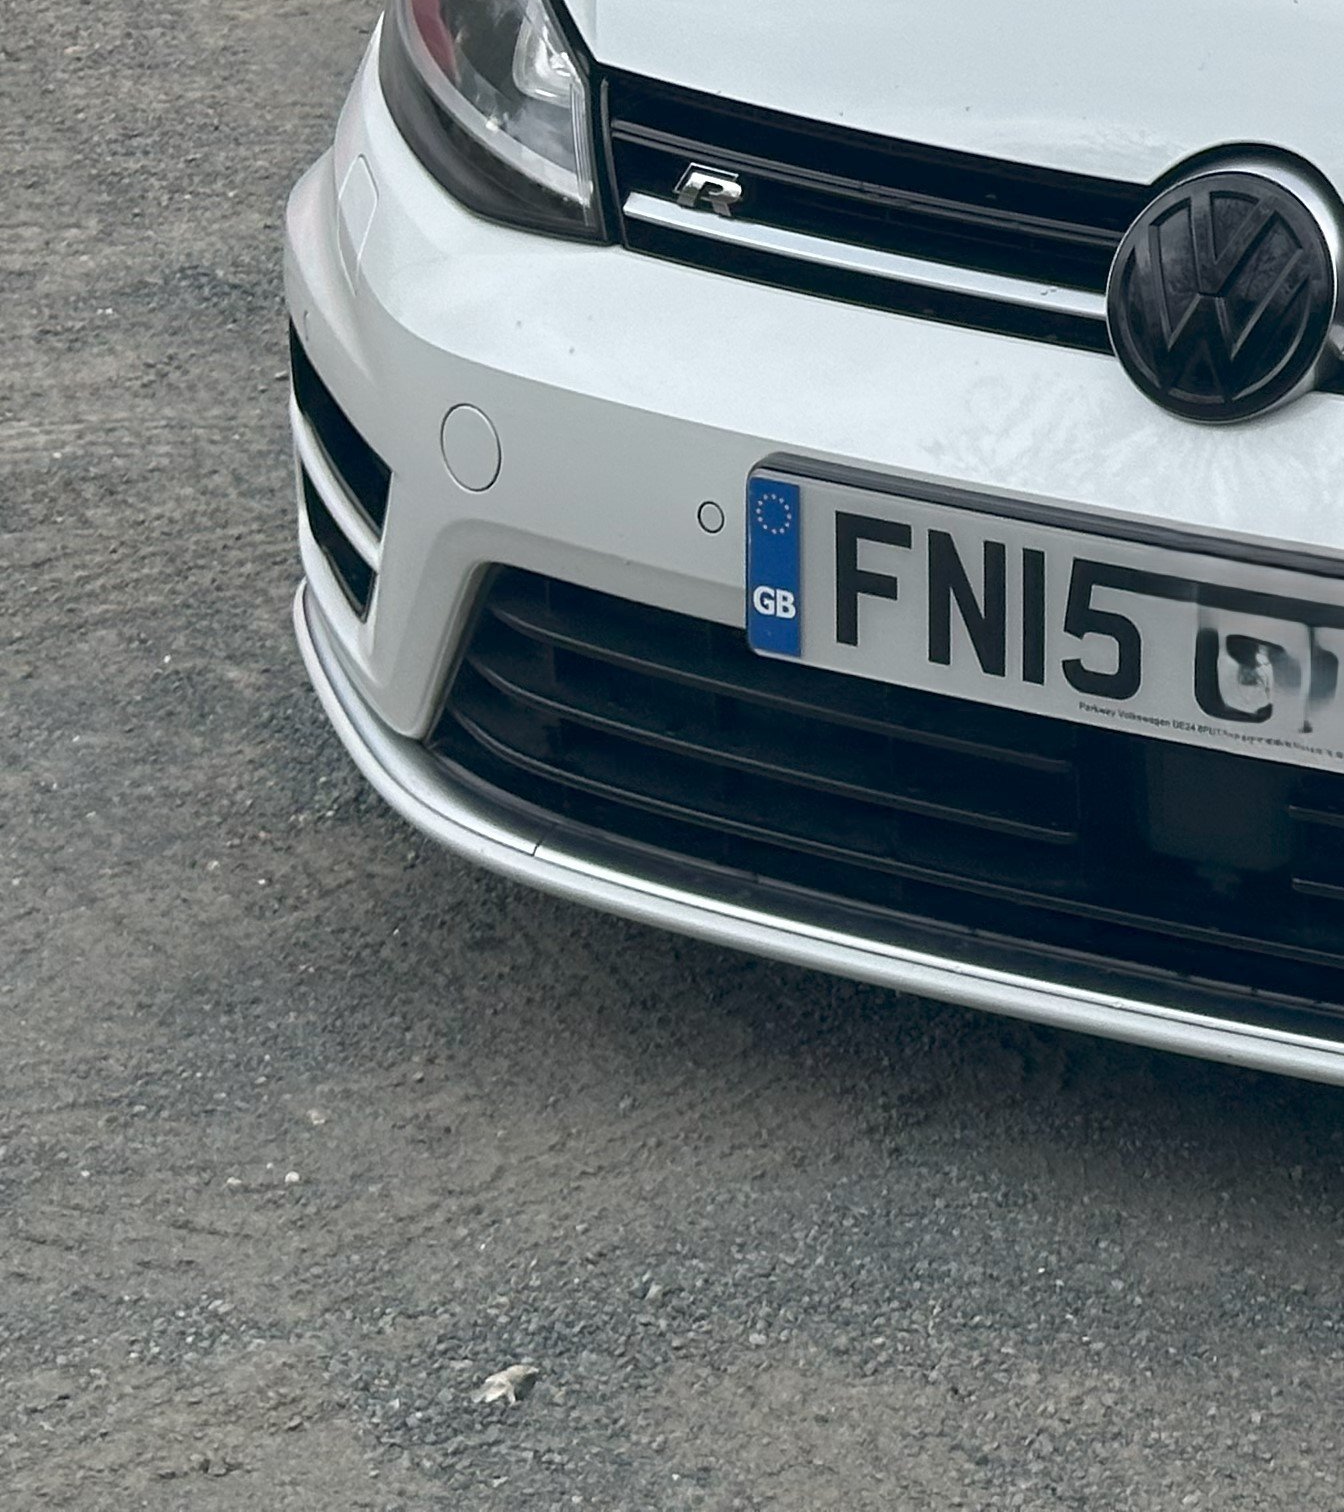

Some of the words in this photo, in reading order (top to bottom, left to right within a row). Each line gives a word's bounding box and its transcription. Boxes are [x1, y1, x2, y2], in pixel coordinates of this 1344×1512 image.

[674, 164, 742, 217] R
[1117, 180, 1325, 410] VW
[753, 586, 796, 619] GB
[1078, 701, 1116, 718] Parkway
[1118, 708, 1171, 729] Volkswagen
